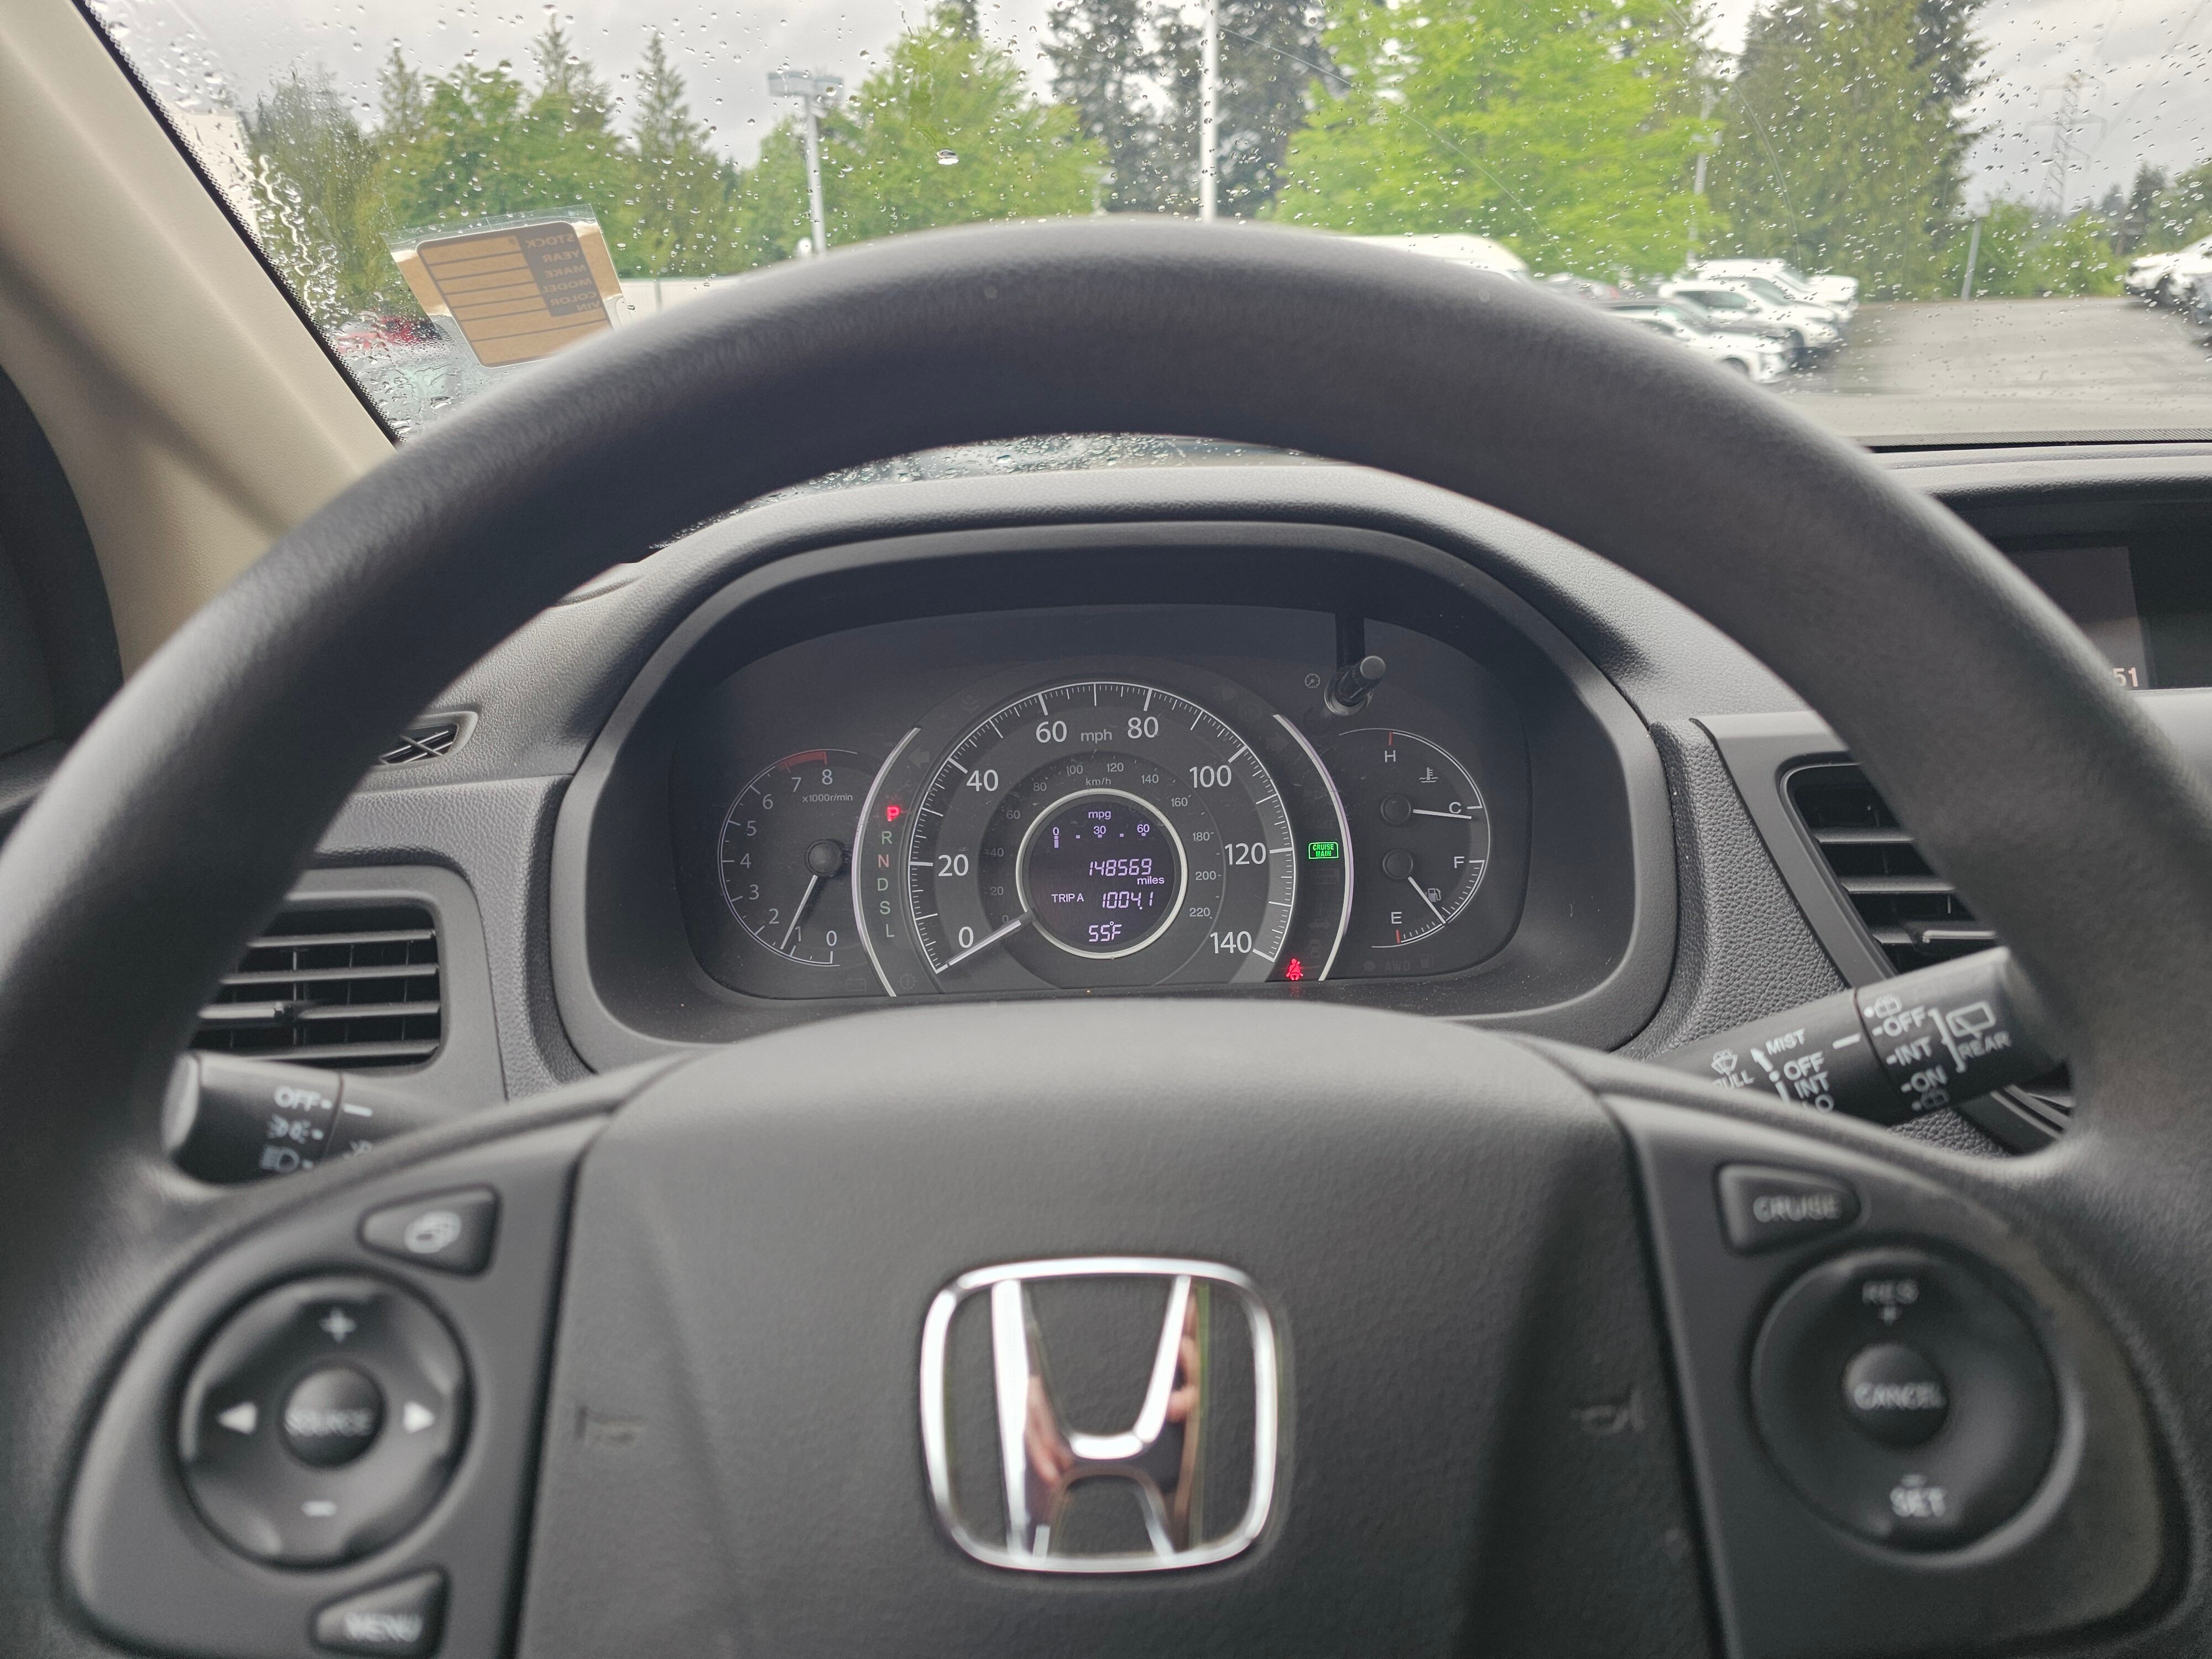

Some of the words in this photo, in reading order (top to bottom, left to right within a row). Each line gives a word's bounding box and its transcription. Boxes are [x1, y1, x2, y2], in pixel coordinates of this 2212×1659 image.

[1036, 721, 1067, 743] 60
[1127, 716, 1159, 738] 80
[1080, 729, 1113, 744] mph
[1384, 750, 1396, 762] H
[1066, 765, 1083, 775] 100
[1107, 763, 1124, 773] 120
[822, 769, 832, 785] 8
[966, 769, 999, 792] 40
[1085, 777, 1112, 786] km/h
[1141, 774, 1159, 784] 140
[1189, 765, 1232, 788] 100
[791, 777, 802, 792] 7
[1033, 782, 1047, 792] 80
[763, 794, 773, 810] 6
[802, 793, 853, 803] x1000r/min
[1171, 797, 1188, 807] 160
[887, 805, 899, 821] P
[1006, 810, 1020, 820] 60
[1088, 811, 1111, 820] mpg
[1449, 802, 1462, 814] C
[747, 821, 757, 836] 5
[1053, 827, 1059, 836] 0
[1093, 826, 1106, 834] 30
[1137, 824, 1150, 833] 60
[882, 832, 892, 844] R
[1192, 832, 1210, 842] 180
[990, 847, 1004, 857] 40
[1224, 842, 1266, 864] 120
[740, 853, 751, 868] 4
[878, 854, 889, 867] N
[938, 854, 969, 877] 20
[1089, 858, 1152, 876] 148569
[1454, 857, 1464, 869] F
[1137, 876, 1165, 885] miles
[1195, 871, 1216, 881] 200
[878, 879, 888, 890] D
[990, 886, 1004, 896] 20
[749, 885, 759, 900] 3
[880, 901, 890, 914] S
[1051, 894, 1075, 902] TRIP
[1077, 893, 1084, 902] A
[1102, 891, 1154, 910] 1004.1
[769, 909, 779, 924] 2
[1189, 907, 1211, 917] 220
[1391, 912, 1402, 924] E
[795, 926, 801, 941] 1
[826, 931, 837, 946] 0
[886, 925, 895, 937] L
[958, 926, 974, 948] 0
[1210, 931, 1252, 953] 140
[1884, 1007, 1927, 1036] OFF
[1766, 1029, 1806, 1055] MIST
[1958, 1032, 2012, 1060] REAR
[1895, 1036, 1932, 1066] INT
[1783, 1051, 1824, 1080] OFF
[1794, 1071, 1829, 1099] INT
[1911, 1066, 1947, 1092] ON
[275, 1086, 322, 1112] OFF
